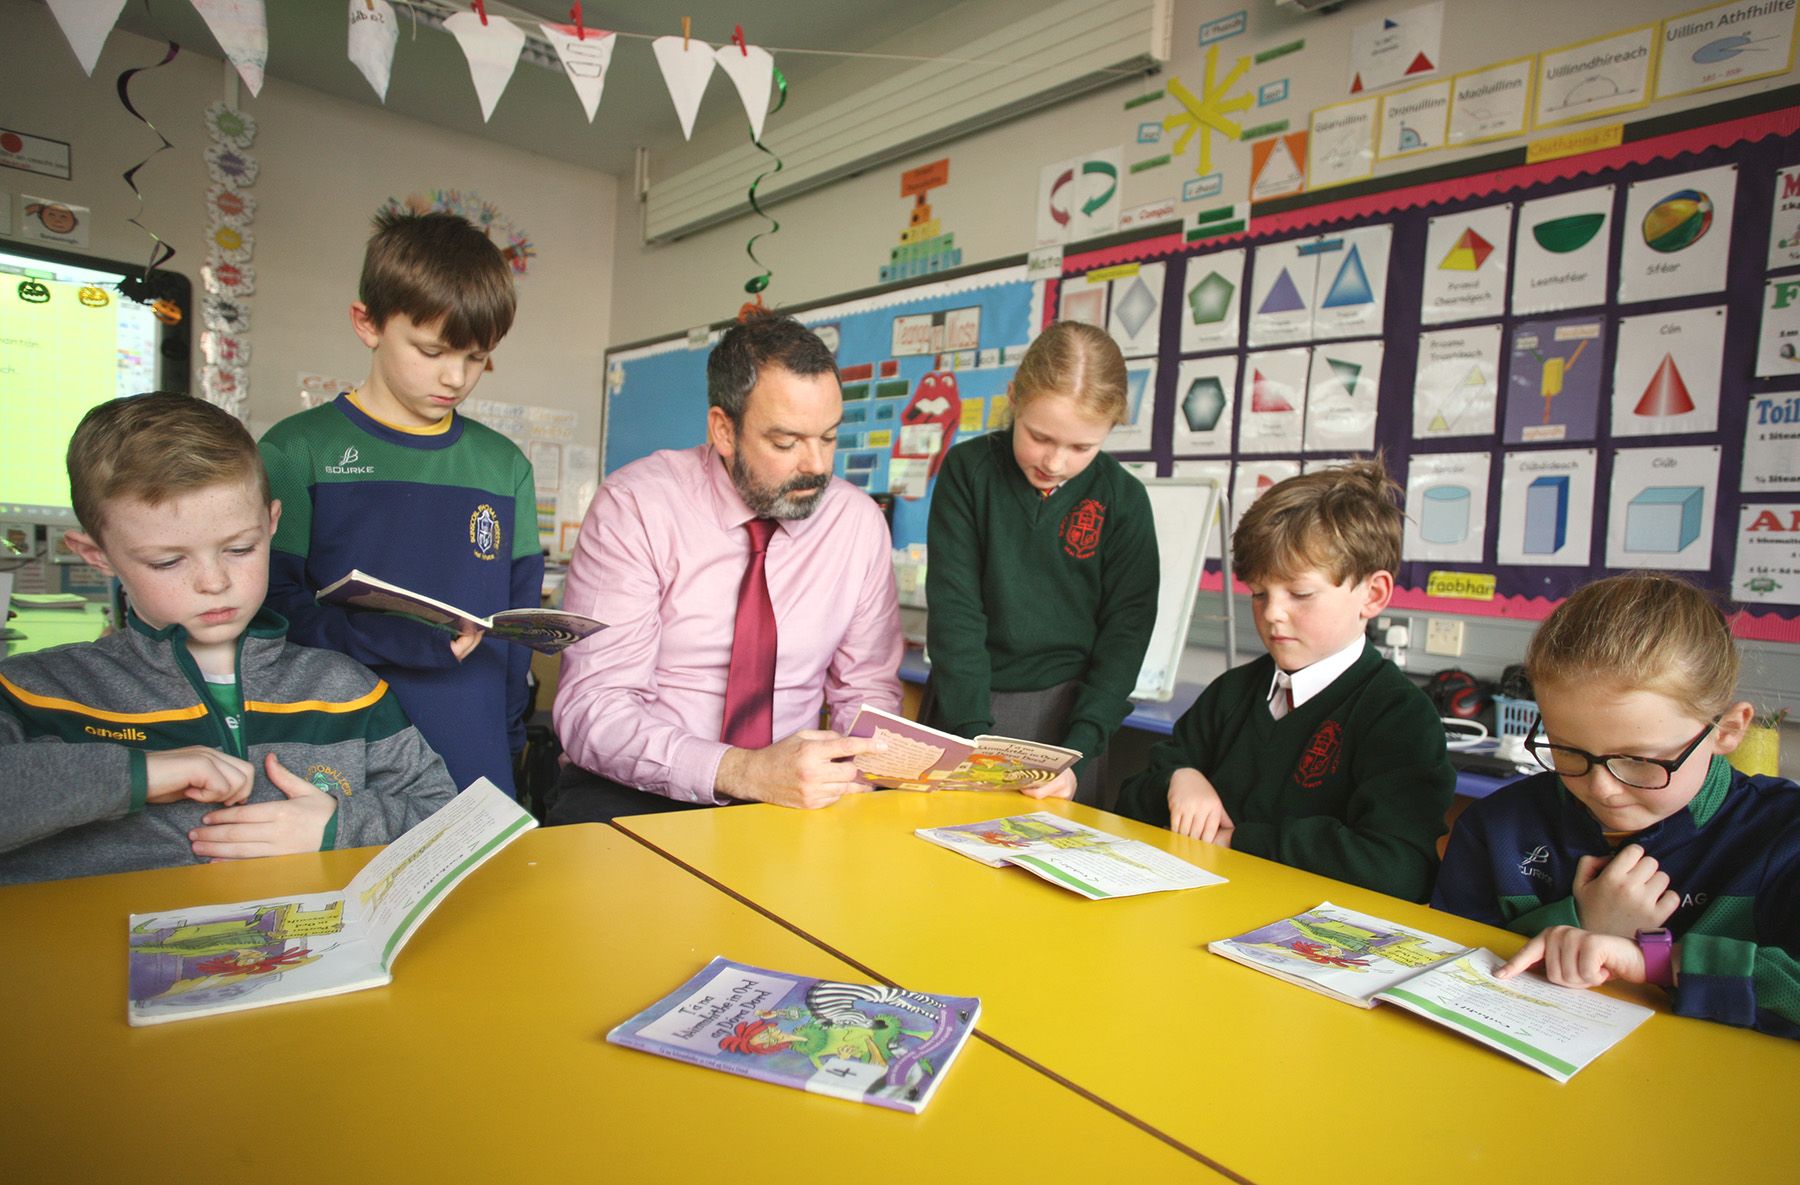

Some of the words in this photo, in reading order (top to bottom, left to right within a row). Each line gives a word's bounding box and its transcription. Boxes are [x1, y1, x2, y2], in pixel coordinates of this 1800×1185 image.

[1666, 17, 1714, 41] Uillinn
[1717, 0, 1796, 28] Athfhillte
[325, 465, 375, 475] BOURKE
[1429, 575, 1493, 596] faobhar
[731, 978, 760, 995] Ord
[825, 1057, 857, 1079] 4
